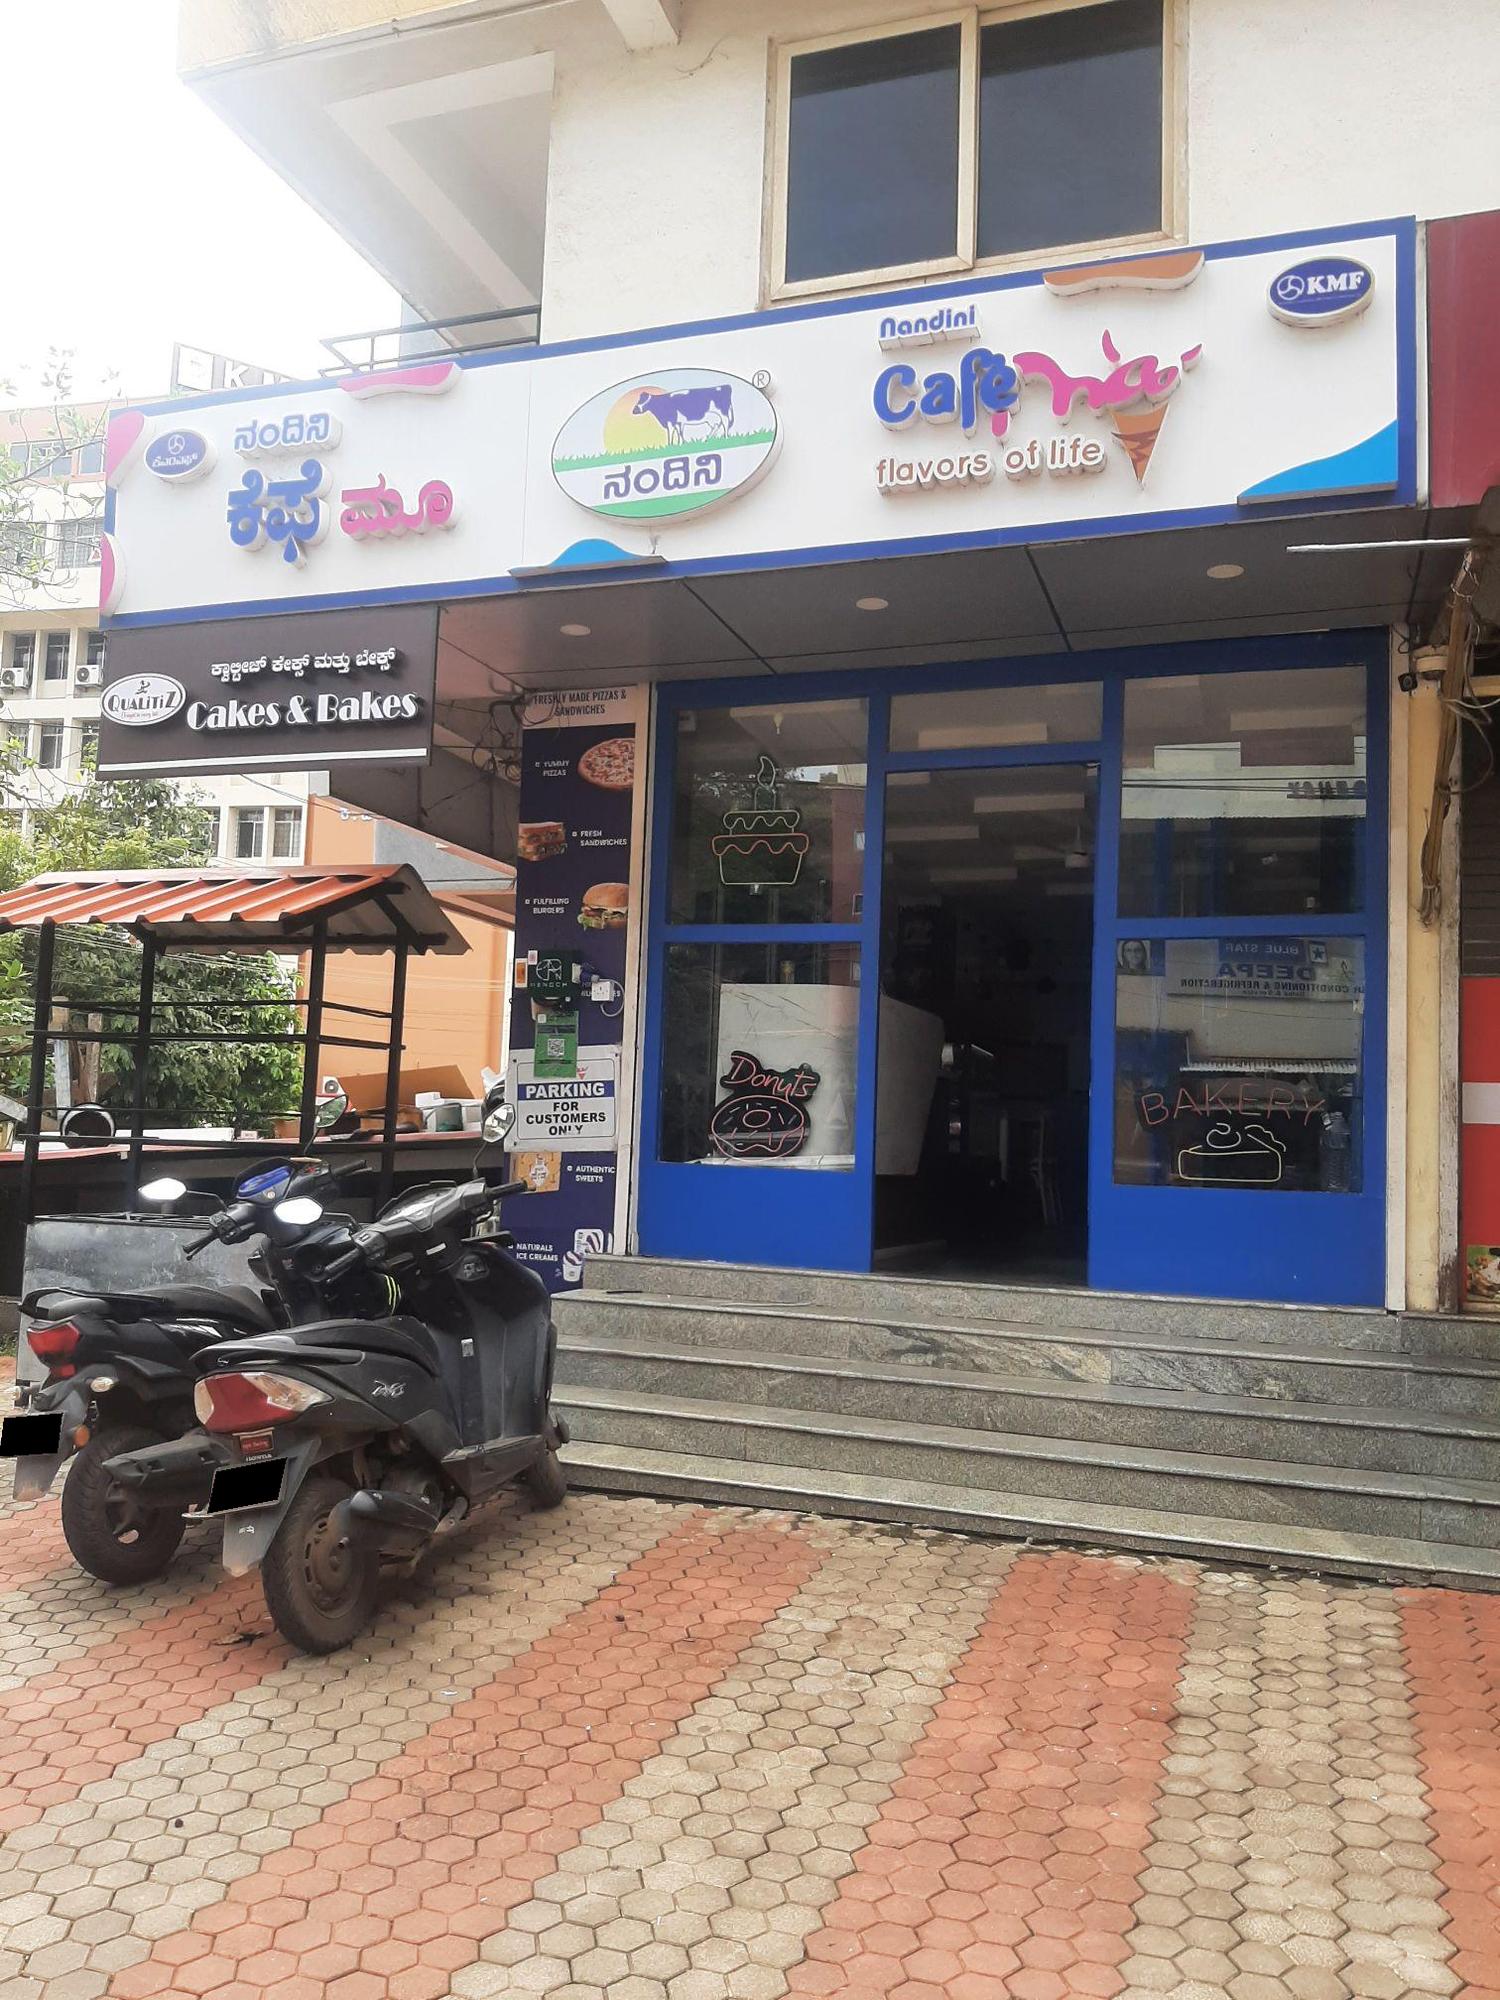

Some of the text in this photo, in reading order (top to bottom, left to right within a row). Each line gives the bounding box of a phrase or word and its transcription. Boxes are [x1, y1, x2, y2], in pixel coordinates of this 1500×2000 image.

[1307, 271, 1365, 295] KMF
[880, 304, 976, 338] Nandini
[234, 412, 331, 452] ನಂದಿನಿ
[876, 437, 1101, 484] flavors of life
[603, 453, 722, 500] ನಂದಿನಿ
[313, 652, 351, 674] ಮತ್ತು
[568, 692, 591, 703] MADE
[592, 690, 619, 701] PIZZAS
[620, 689, 627, 699] &
[186, 690, 420, 731] Cakes & Bakes
[580, 838, 628, 847] SANDWICHES
[533, 906, 565, 915] BURGERS
[724, 1055, 817, 1103] Donuts
[525, 1082, 605, 1099] PARKING
[553, 1101, 579, 1112] FOR
[1140, 1082, 1326, 1127] BAKERY
[526, 1112, 606, 1125] CUSTOMERS
[575, 1165, 616, 1174] AUTHENTIC
[516, 1252, 559, 1261] ICE CREAMS
